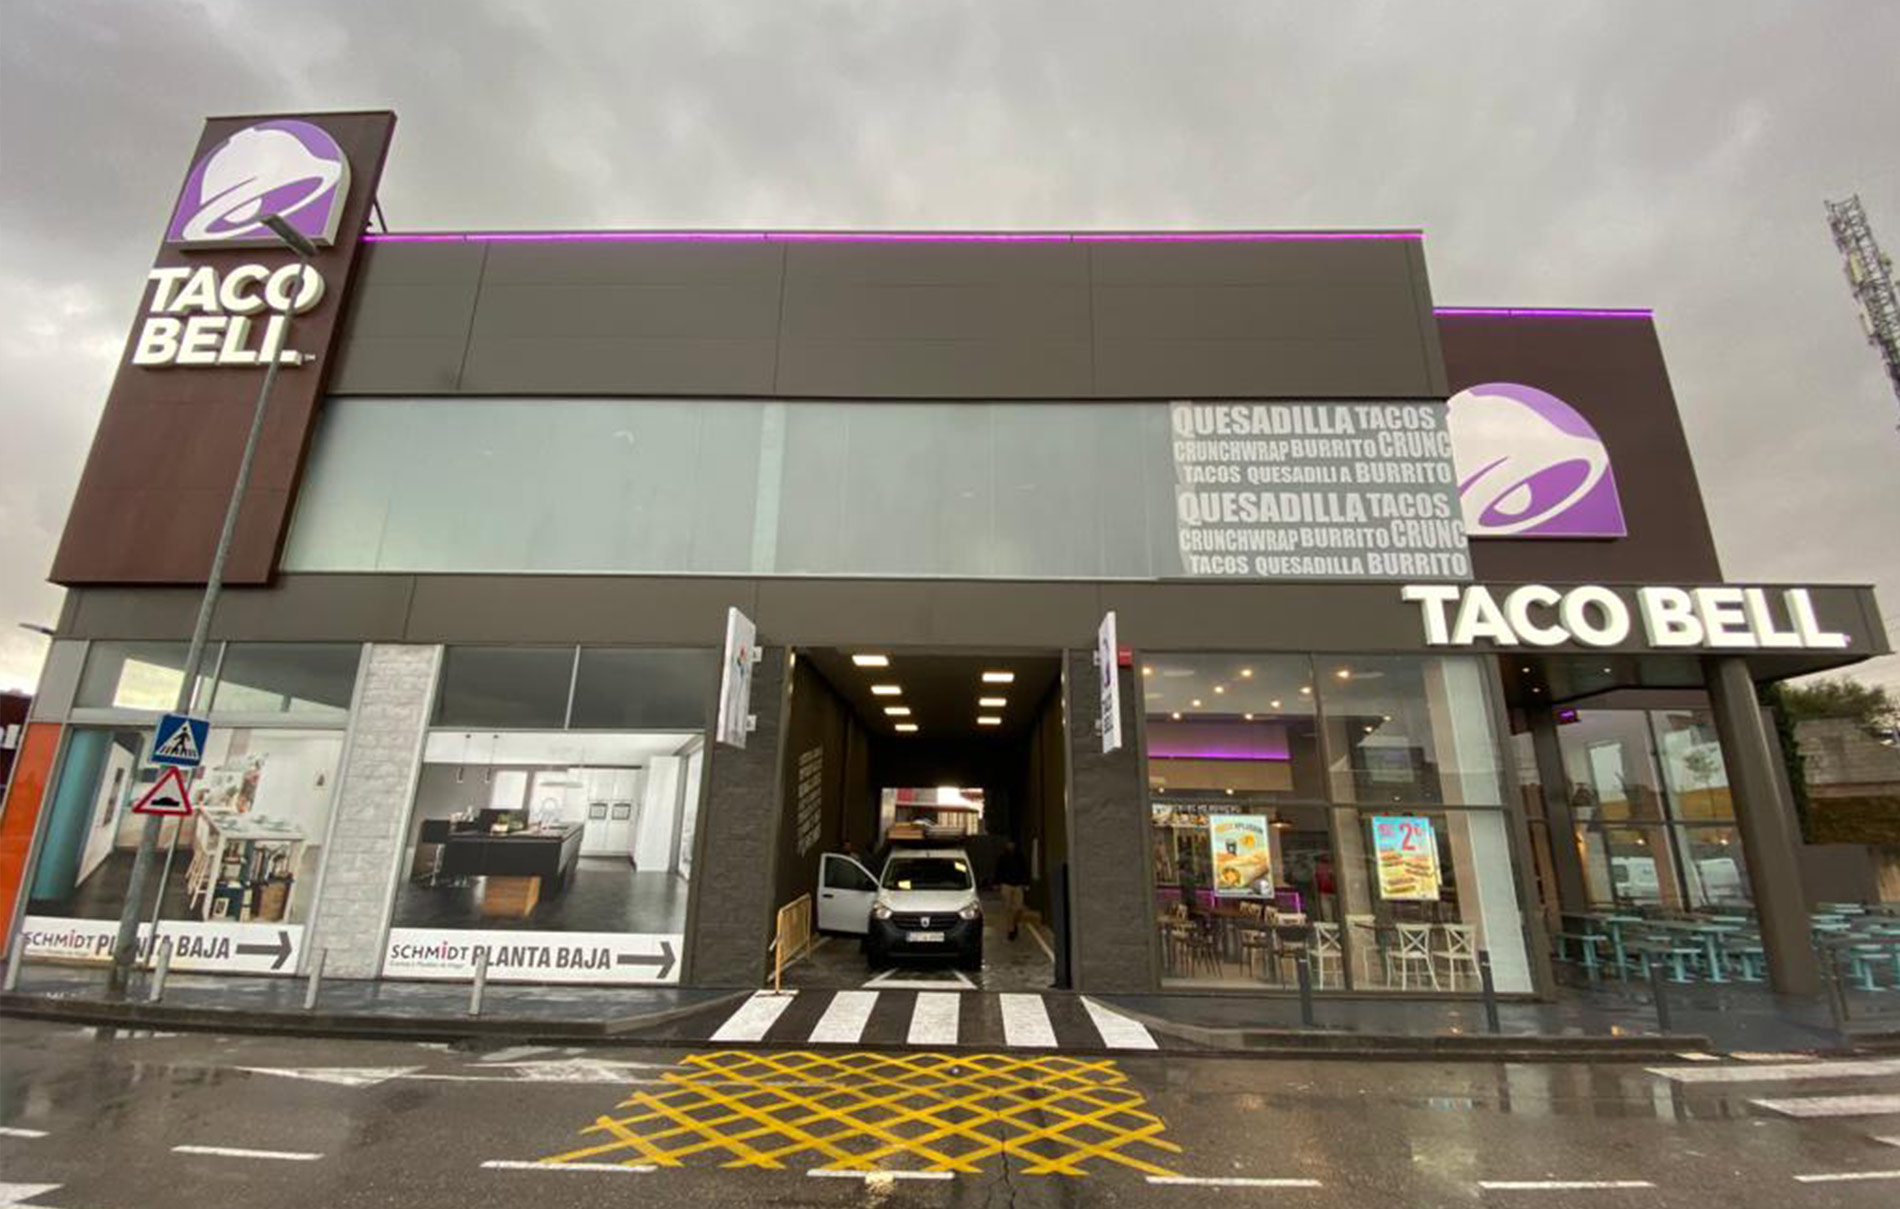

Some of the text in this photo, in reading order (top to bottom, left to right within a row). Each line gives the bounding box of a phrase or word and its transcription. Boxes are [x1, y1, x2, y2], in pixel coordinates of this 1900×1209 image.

[148, 263, 325, 315] TACO
[132, 315, 302, 367] BELL
[1172, 405, 1436, 439] QUESADILLA TACOS
[1174, 431, 1452, 462] CRUNCHWRAP BURRITO CRUNC
[1183, 465, 1241, 483] TACOS
[1355, 461, 1451, 483] BURRITO
[1178, 492, 1451, 526] QUESADILLA TACOS
[1180, 519, 1467, 551] CRUNCHWRAP BURRITO CRUNC
[1189, 552, 1468, 577] TACOS QUESADILLA BURRITO
[1401, 585, 1847, 648] TACO BELL
[175, 935, 230, 960] BAJA
[471, 945, 551, 968] PLANTA
[555, 946, 612, 970] BAJA
